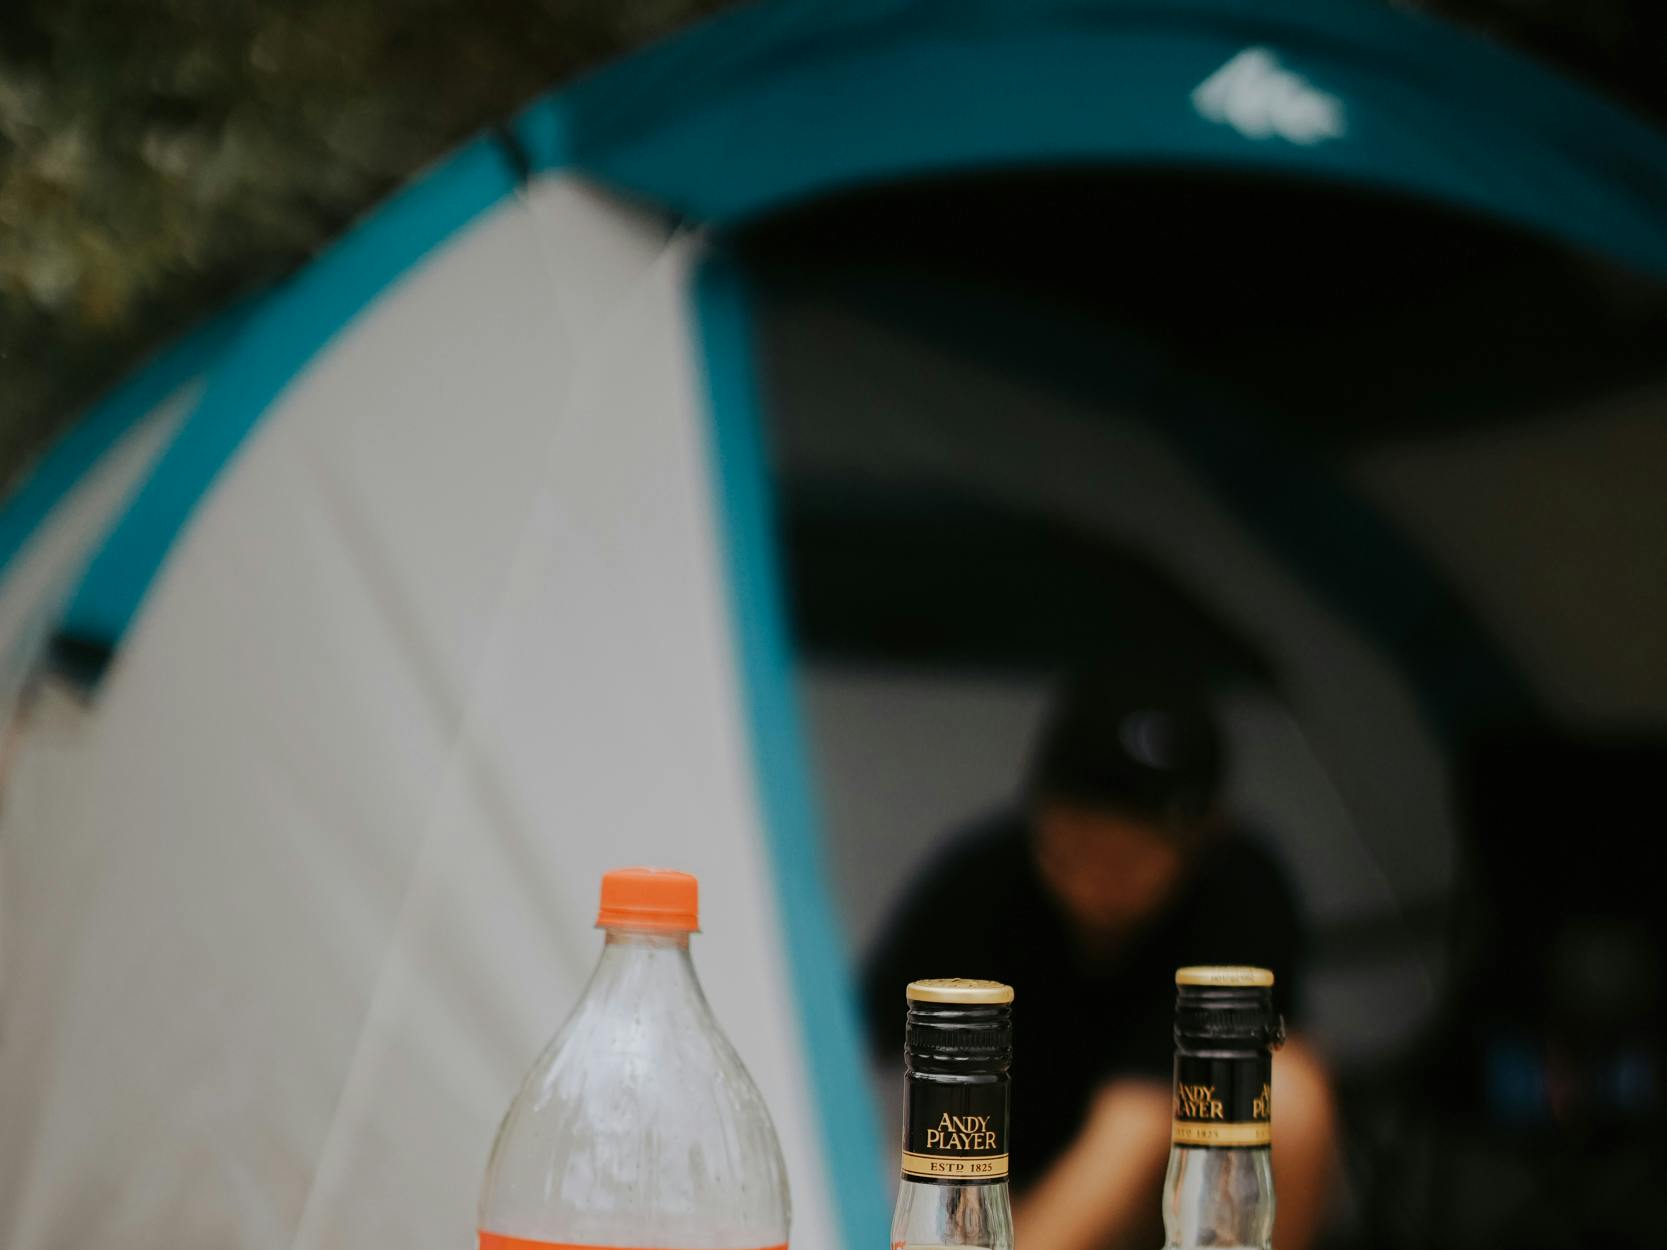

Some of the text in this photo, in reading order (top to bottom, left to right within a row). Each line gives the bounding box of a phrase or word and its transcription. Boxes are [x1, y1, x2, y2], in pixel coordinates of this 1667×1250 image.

[938, 1112, 991, 1133] ANDY
[926, 1128, 997, 1150] PLAYER
[930, 1162, 993, 1173] ESTD 1825
